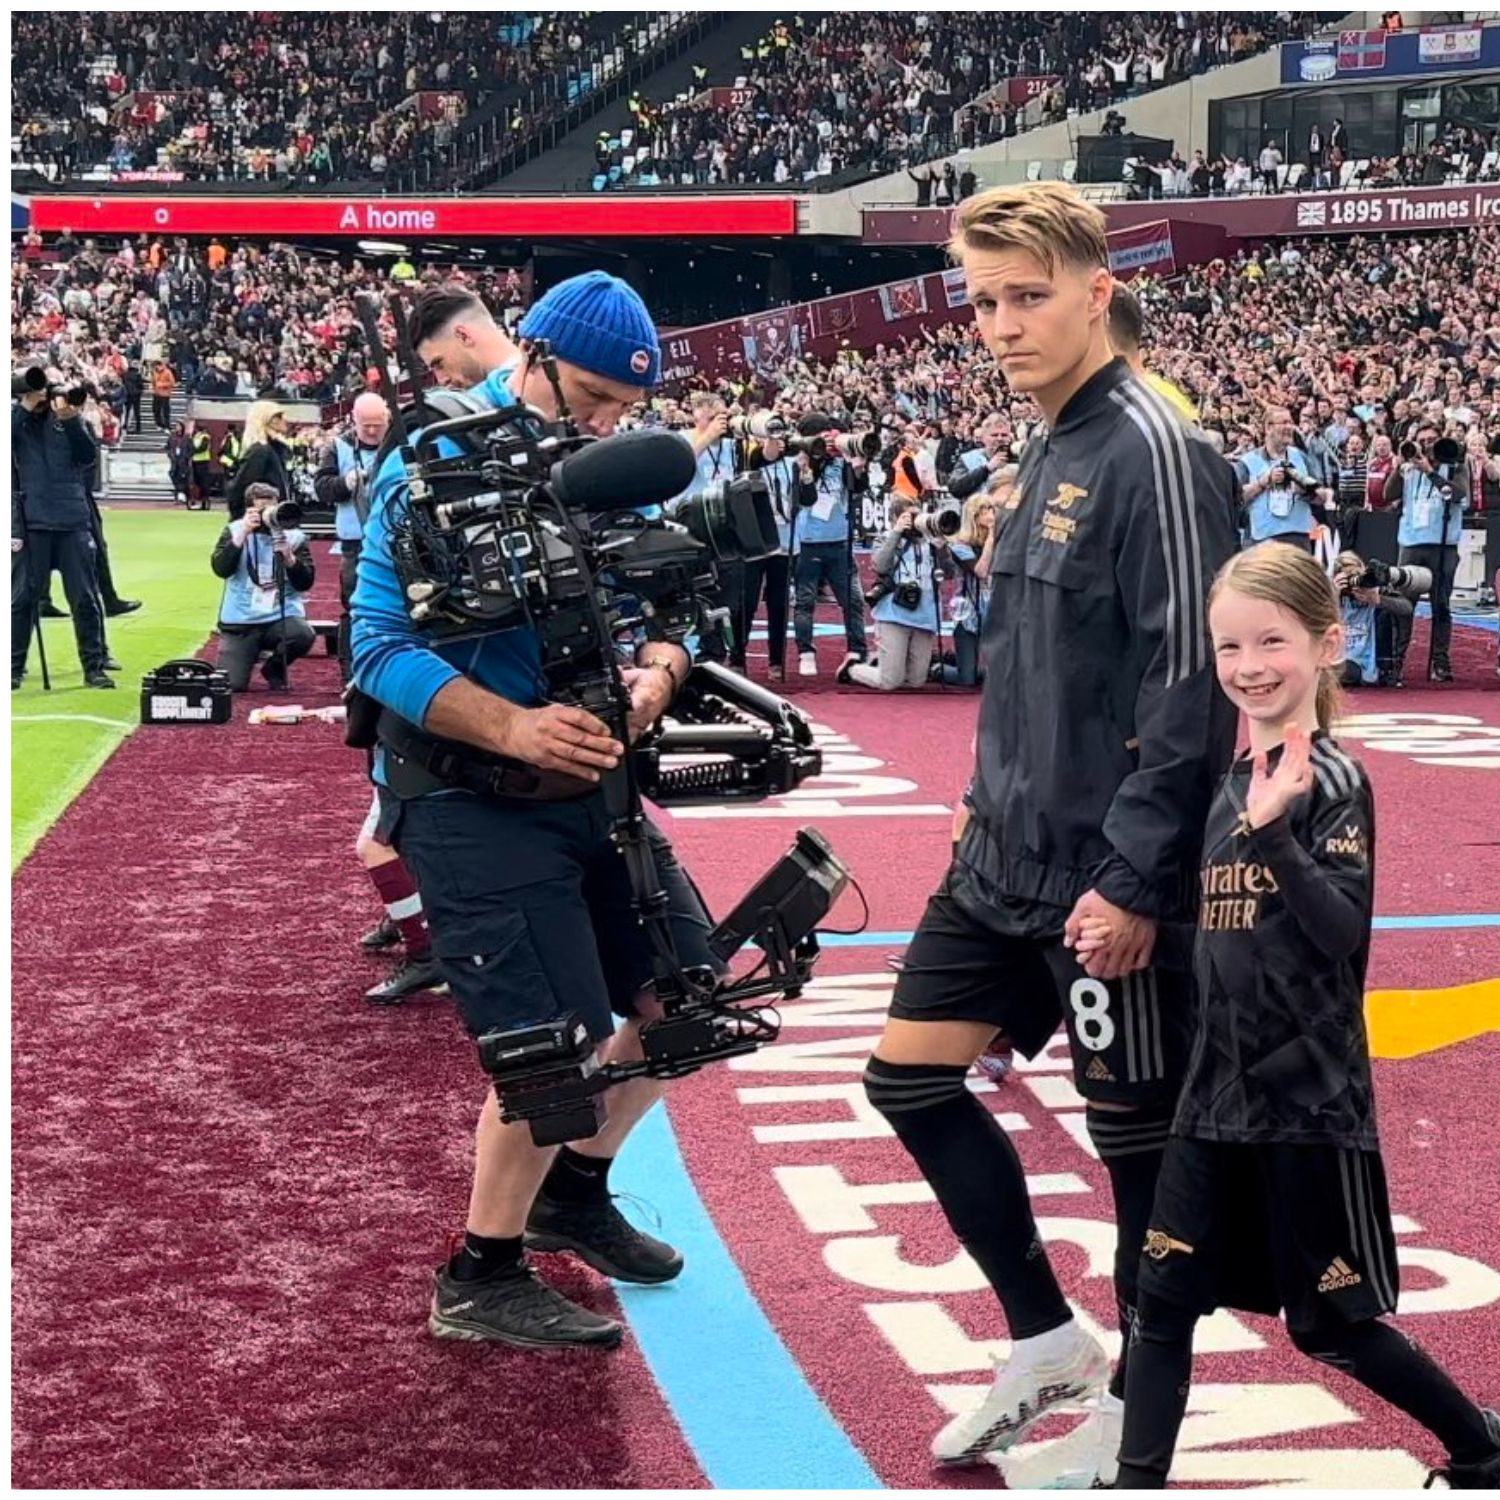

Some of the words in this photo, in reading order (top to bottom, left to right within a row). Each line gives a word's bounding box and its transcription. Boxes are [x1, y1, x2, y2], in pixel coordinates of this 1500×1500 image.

[340, 206, 359, 229] A
[366, 206, 435, 229] home
[1331, 199, 1383, 224] 1895
[1388, 197, 1469, 221] Thames
[1200, 858, 1280, 894] irates
[1069, 977, 1115, 1051] 8
[1318, 1273, 1362, 1292] adidas
